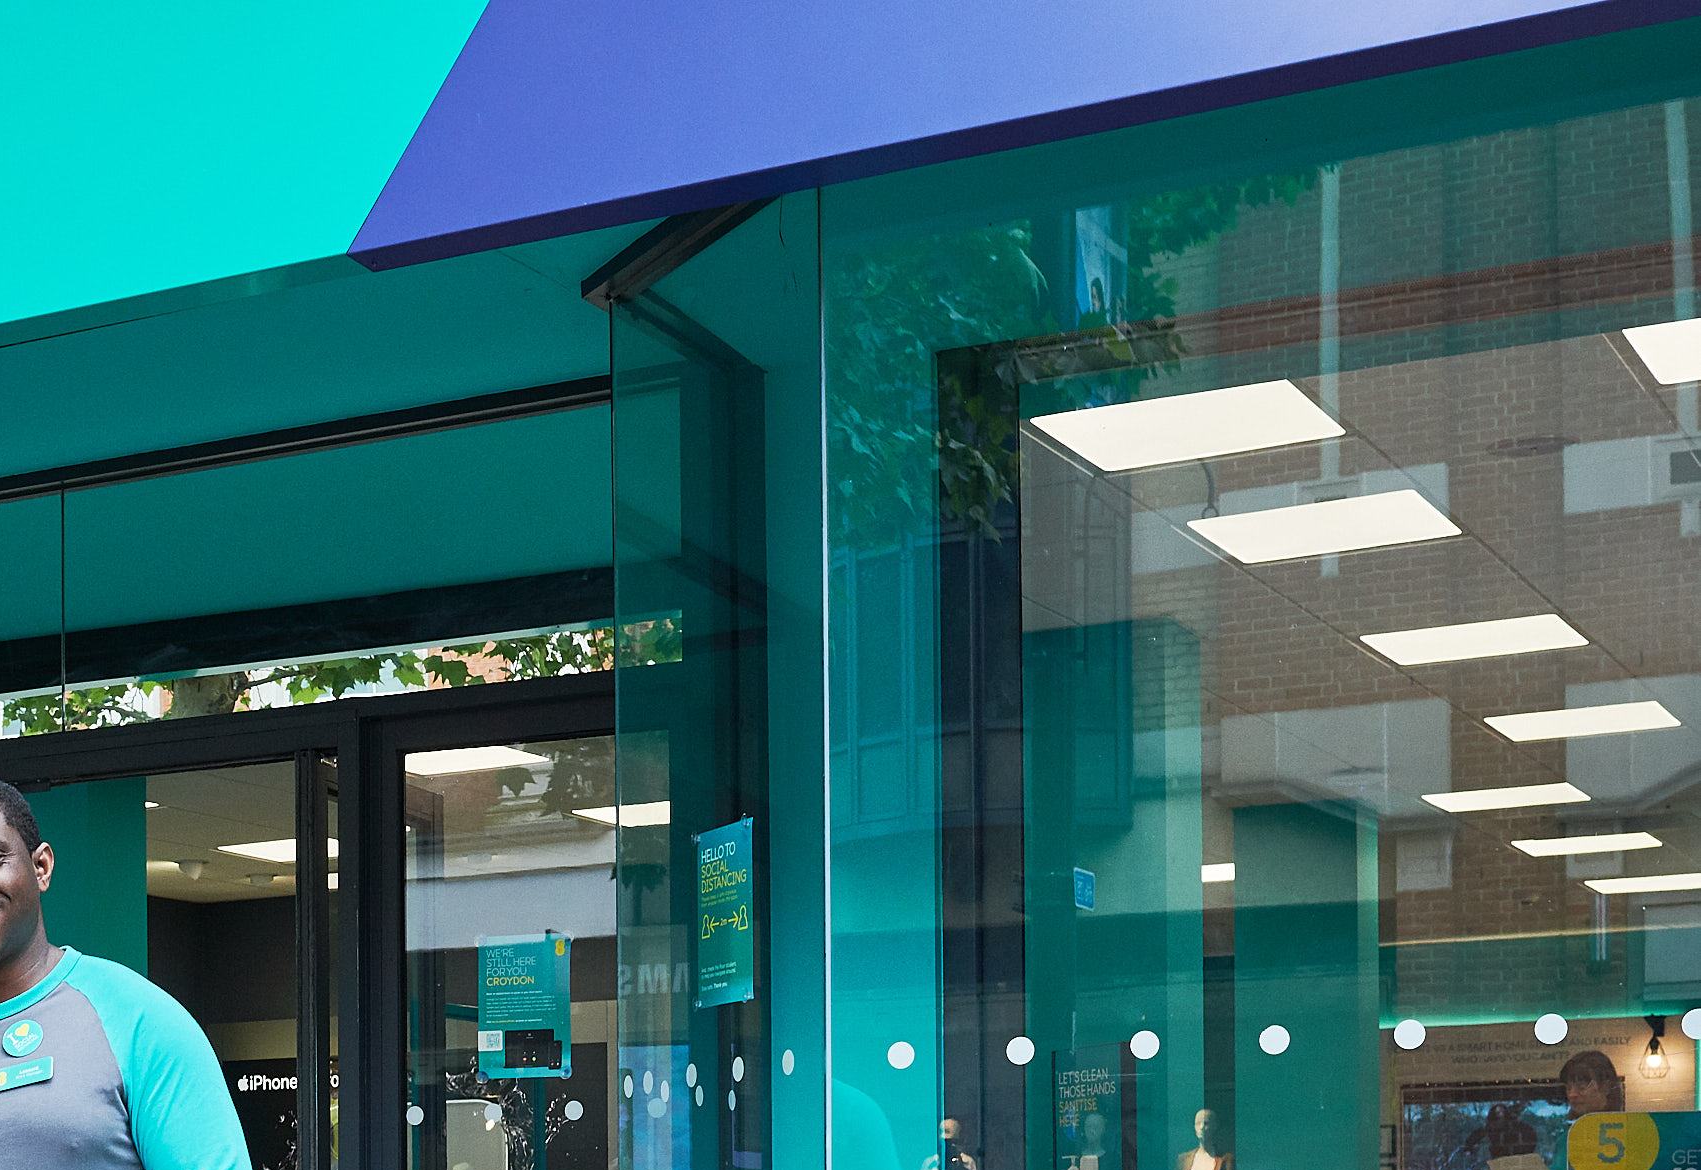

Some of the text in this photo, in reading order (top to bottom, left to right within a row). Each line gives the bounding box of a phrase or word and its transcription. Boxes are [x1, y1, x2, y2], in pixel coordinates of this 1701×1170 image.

[701, 842, 736, 864] HELLO TO
[701, 859, 729, 878] SOCIAL
[701, 869, 747, 894] DISTANCING
[486, 948, 514, 958] WE'RE
[487, 956, 536, 967] STILL HERE
[487, 967, 527, 977] FOR YOU
[486, 976, 535, 986] CROYDON
[1594, 1036, 1632, 1046] EASILY
[249, 1074, 298, 1091] iPhone
[1059, 1068, 1108, 1085] LET'S CLEAN
[1059, 1081, 1116, 1099] THOSE HANDS
[1059, 1098, 1098, 1113] SANITISE
[1059, 1113, 1080, 1128] HERE
